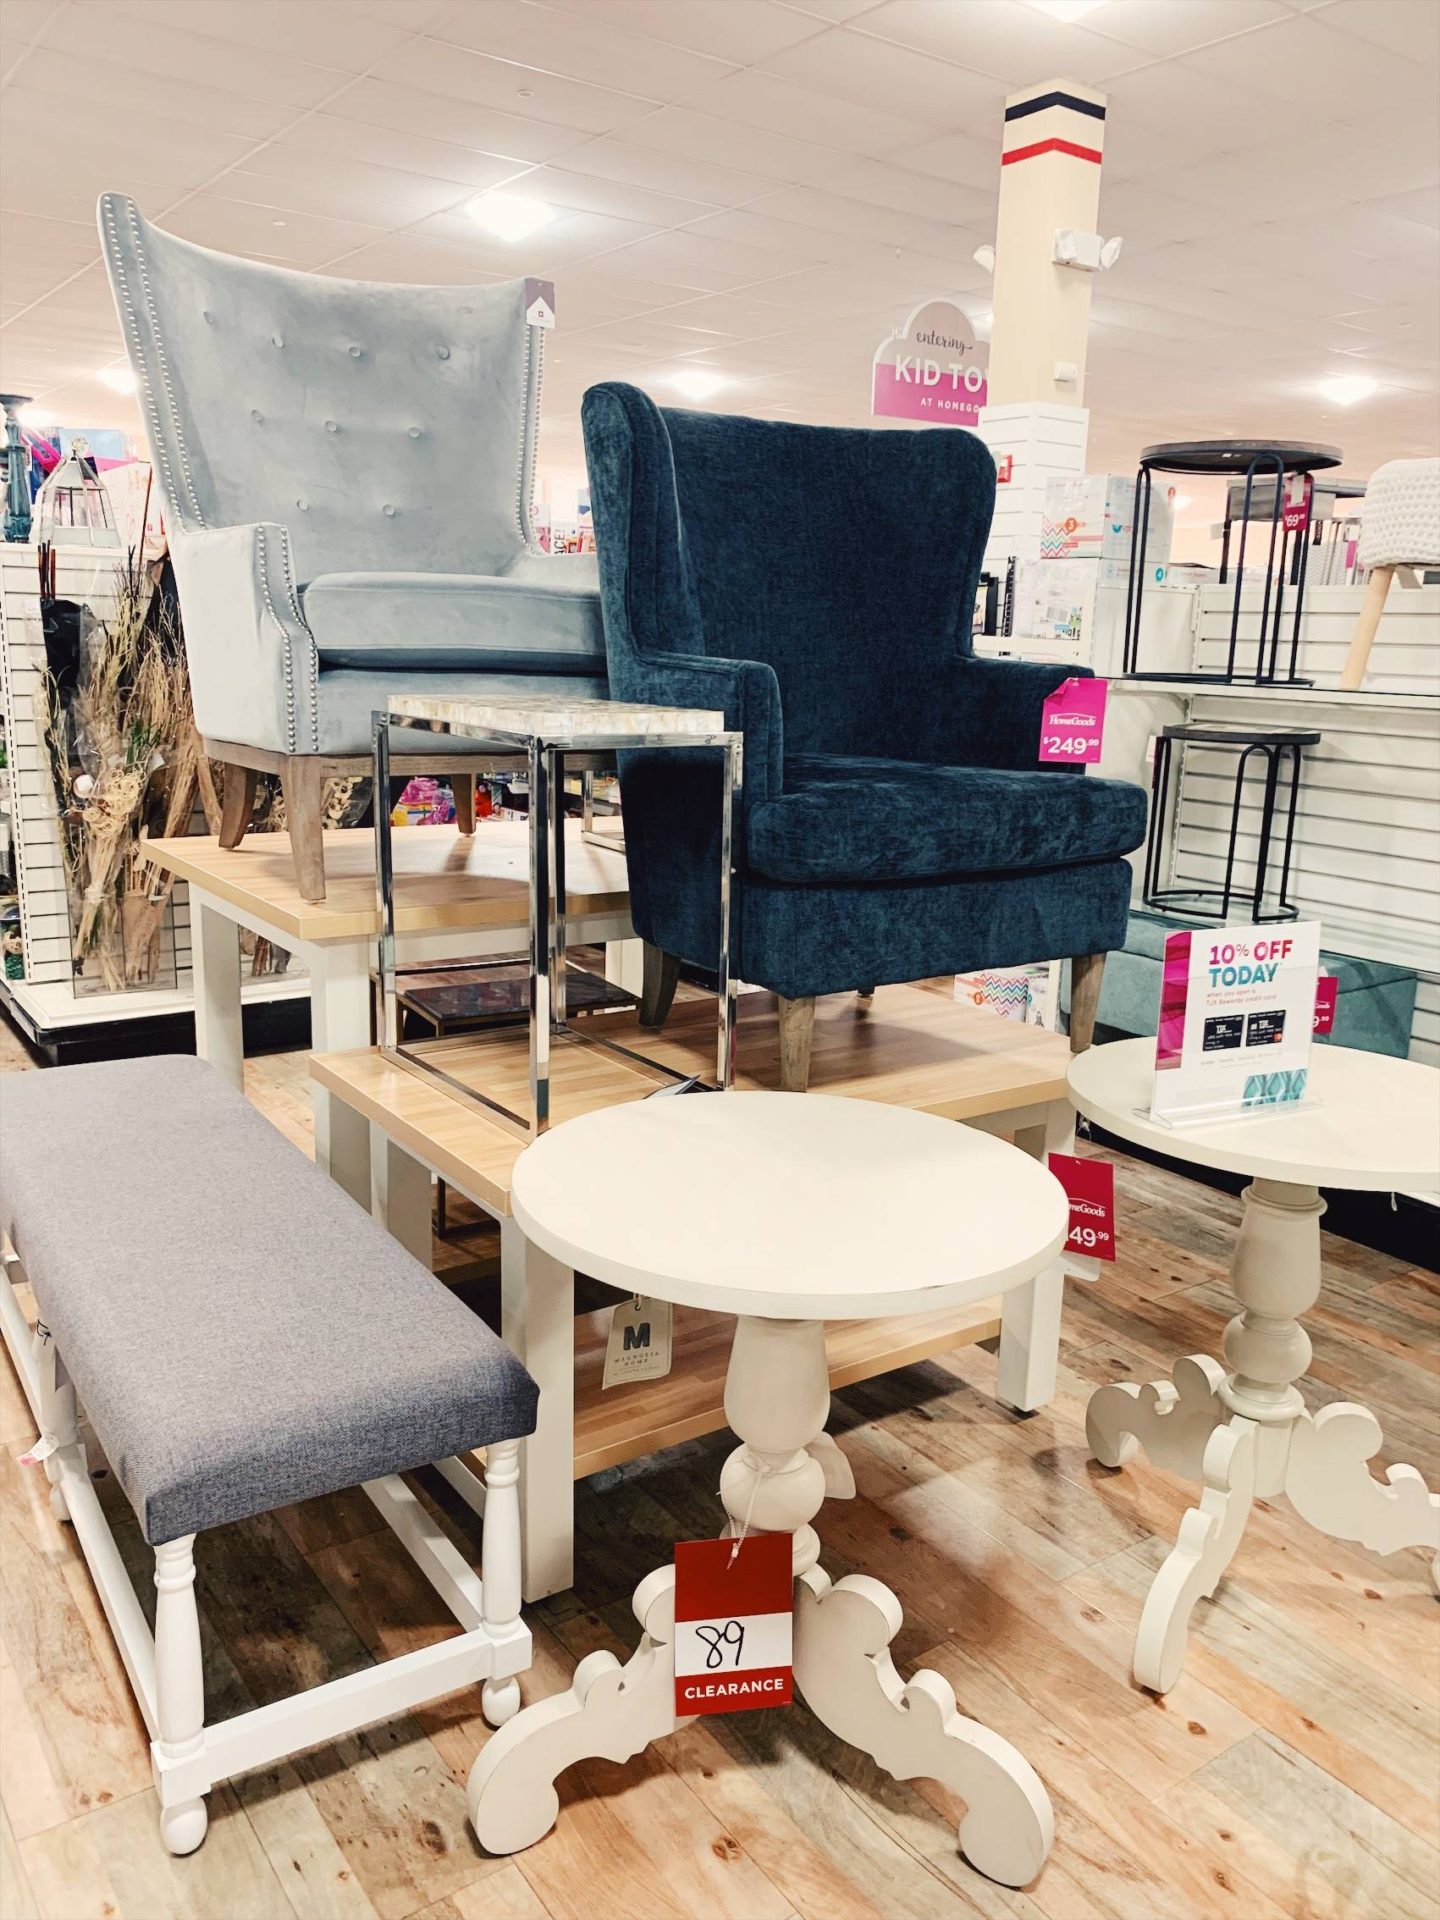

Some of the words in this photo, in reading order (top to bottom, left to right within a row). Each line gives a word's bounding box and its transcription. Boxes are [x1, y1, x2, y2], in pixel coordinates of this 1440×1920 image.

[916, 330, 973, 356] entering
[895, 354, 941, 386] KID
[948, 363, 989, 393] TO
[920, 397, 932, 407] AT
[937, 399, 981, 413] HOMEGO
[1049, 715, 1096, 726] HomeGoods
[1208, 944, 1249, 965] 10%
[1254, 939, 1293, 961] OFF
[1208, 963, 1279, 988] TODAY
[1069, 1203, 1106, 1217] meGoods
[623, 1322, 650, 1350] M
[695, 1620, 745, 1669] 89
[684, 1678, 784, 1699] CLEARANCE
